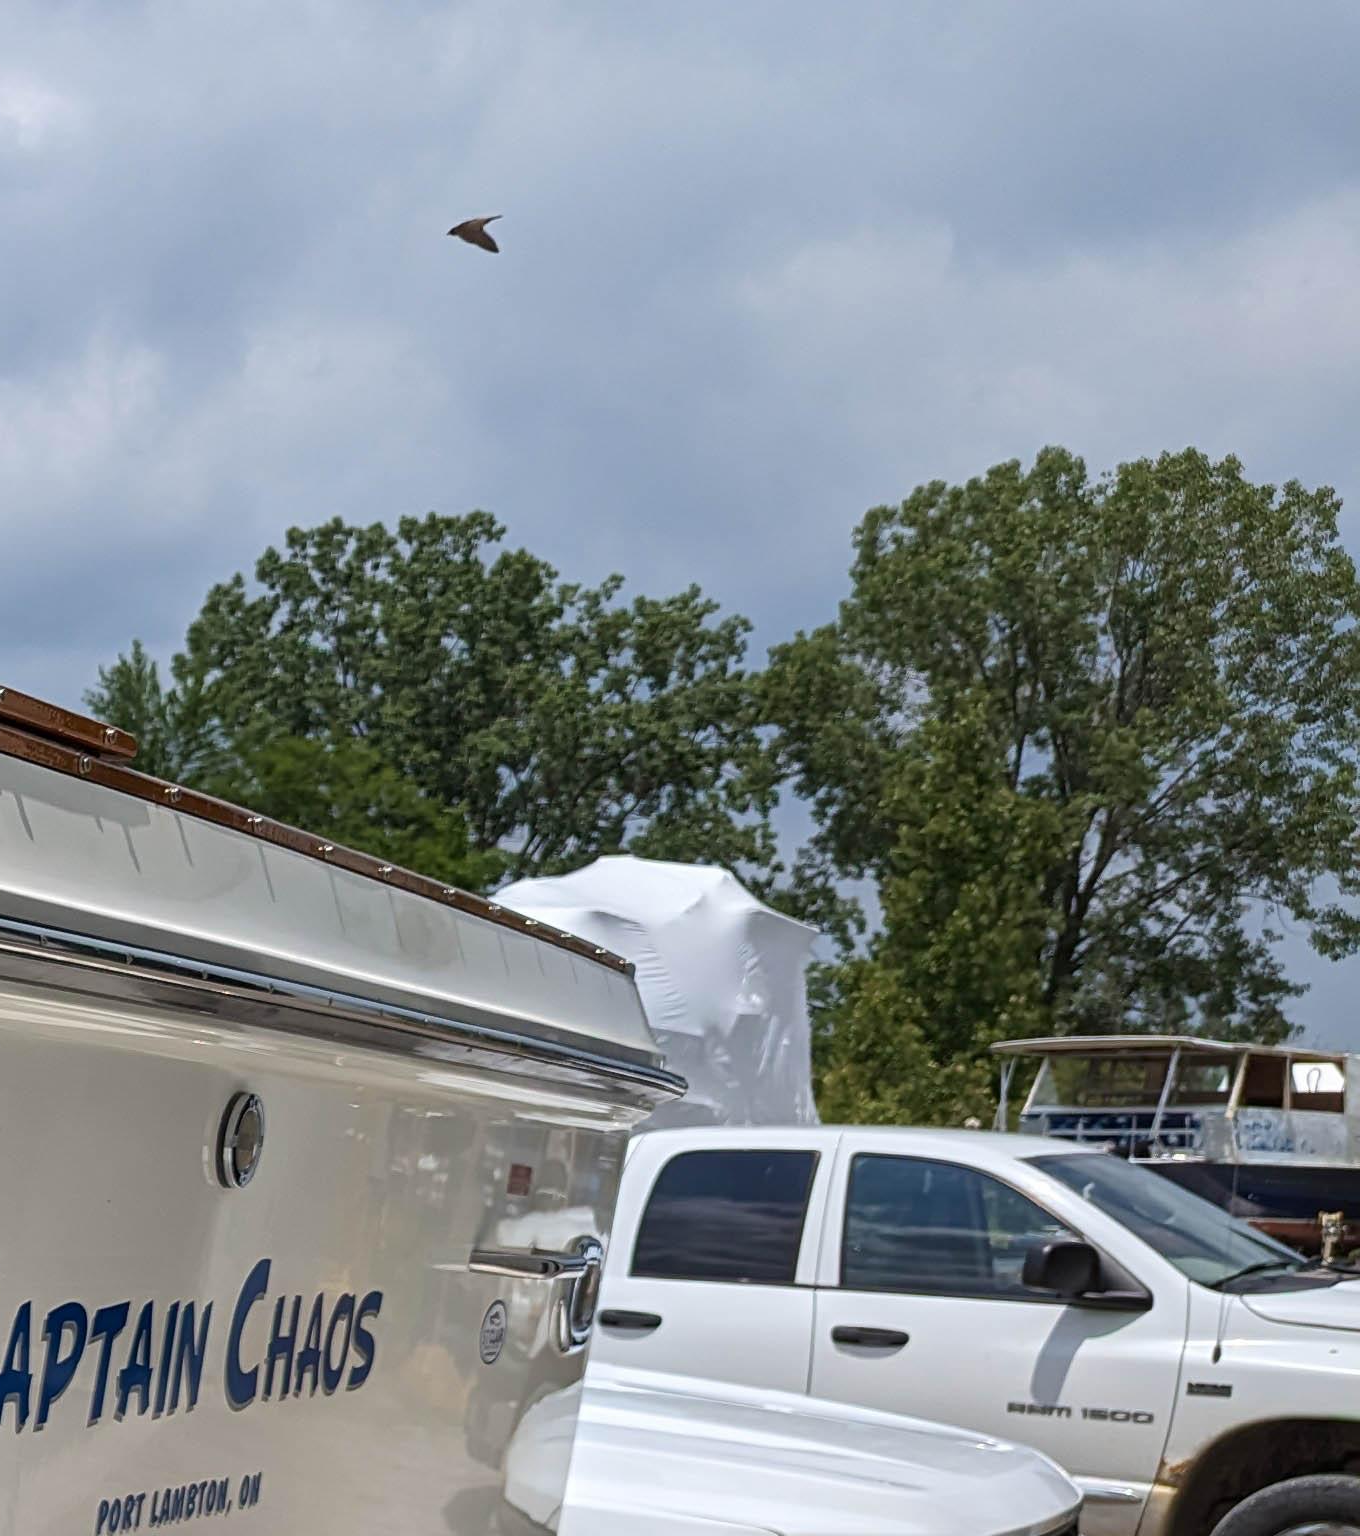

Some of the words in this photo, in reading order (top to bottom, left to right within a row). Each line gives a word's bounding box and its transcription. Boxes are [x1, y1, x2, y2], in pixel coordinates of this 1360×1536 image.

[224, 1258, 384, 1413] CHAOS
[1081, 1407, 1155, 1425] 1500
[148, 1477, 233, 1528] LAMBTON,
[238, 1471, 263, 1510] ON
